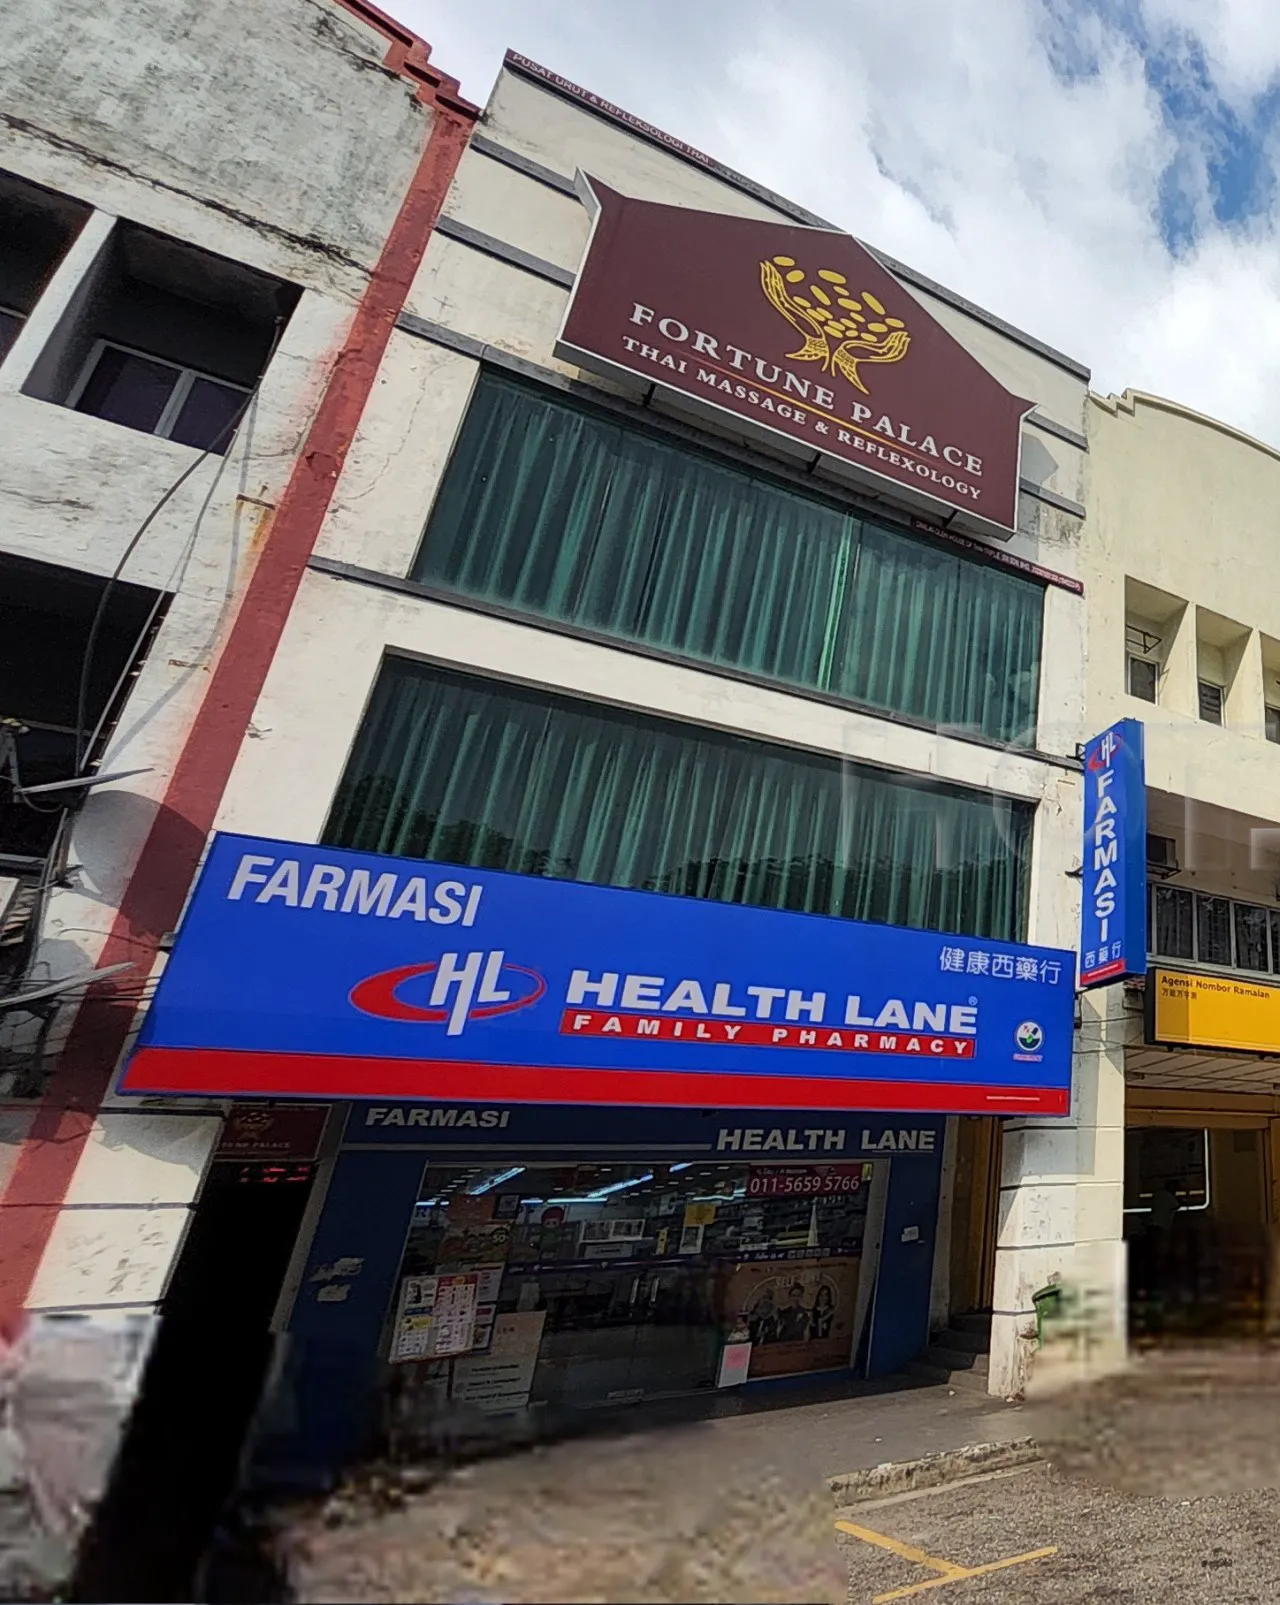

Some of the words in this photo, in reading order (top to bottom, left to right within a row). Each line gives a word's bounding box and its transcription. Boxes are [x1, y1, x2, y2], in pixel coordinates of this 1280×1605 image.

[513, 53, 553, 80] PUSAT
[556, 76, 587, 98] URUT
[600, 100, 683, 151] REFLEKSOLOGI
[686, 145, 709, 165] THAI
[622, 335, 686, 375] THAI
[696, 368, 806, 425] MASSAGE
[814, 420, 830, 436] &
[837, 430, 982, 501] REFLEXOLOGY
[629, 302, 835, 412] FORTUNE
[850, 401, 983, 477] PALACE
[1093, 769, 1118, 943] FARMASI
[227, 854, 484, 928] FARMASI
[429, 950, 511, 1037] HL
[940, 945, 1062, 985] 健康西藥行
[1161, 975, 1193, 988] Agensi
[1195, 980, 1232, 993] Nombor
[1233, 986, 1271, 999] Ramalan
[566, 969, 827, 1024] HEALTH
[843, 994, 978, 1035] LANE
[572, 1013, 743, 1042] FAMILY
[772, 1028, 968, 1056] PHARMACY
[365, 1106, 511, 1128] FARMASI
[716, 1128, 846, 1151] HEALTH
[860, 1129, 936, 1152] LANE
[750, 1176, 821, 1194] 011-5659
[824, 1175, 860, 1191] 5766
